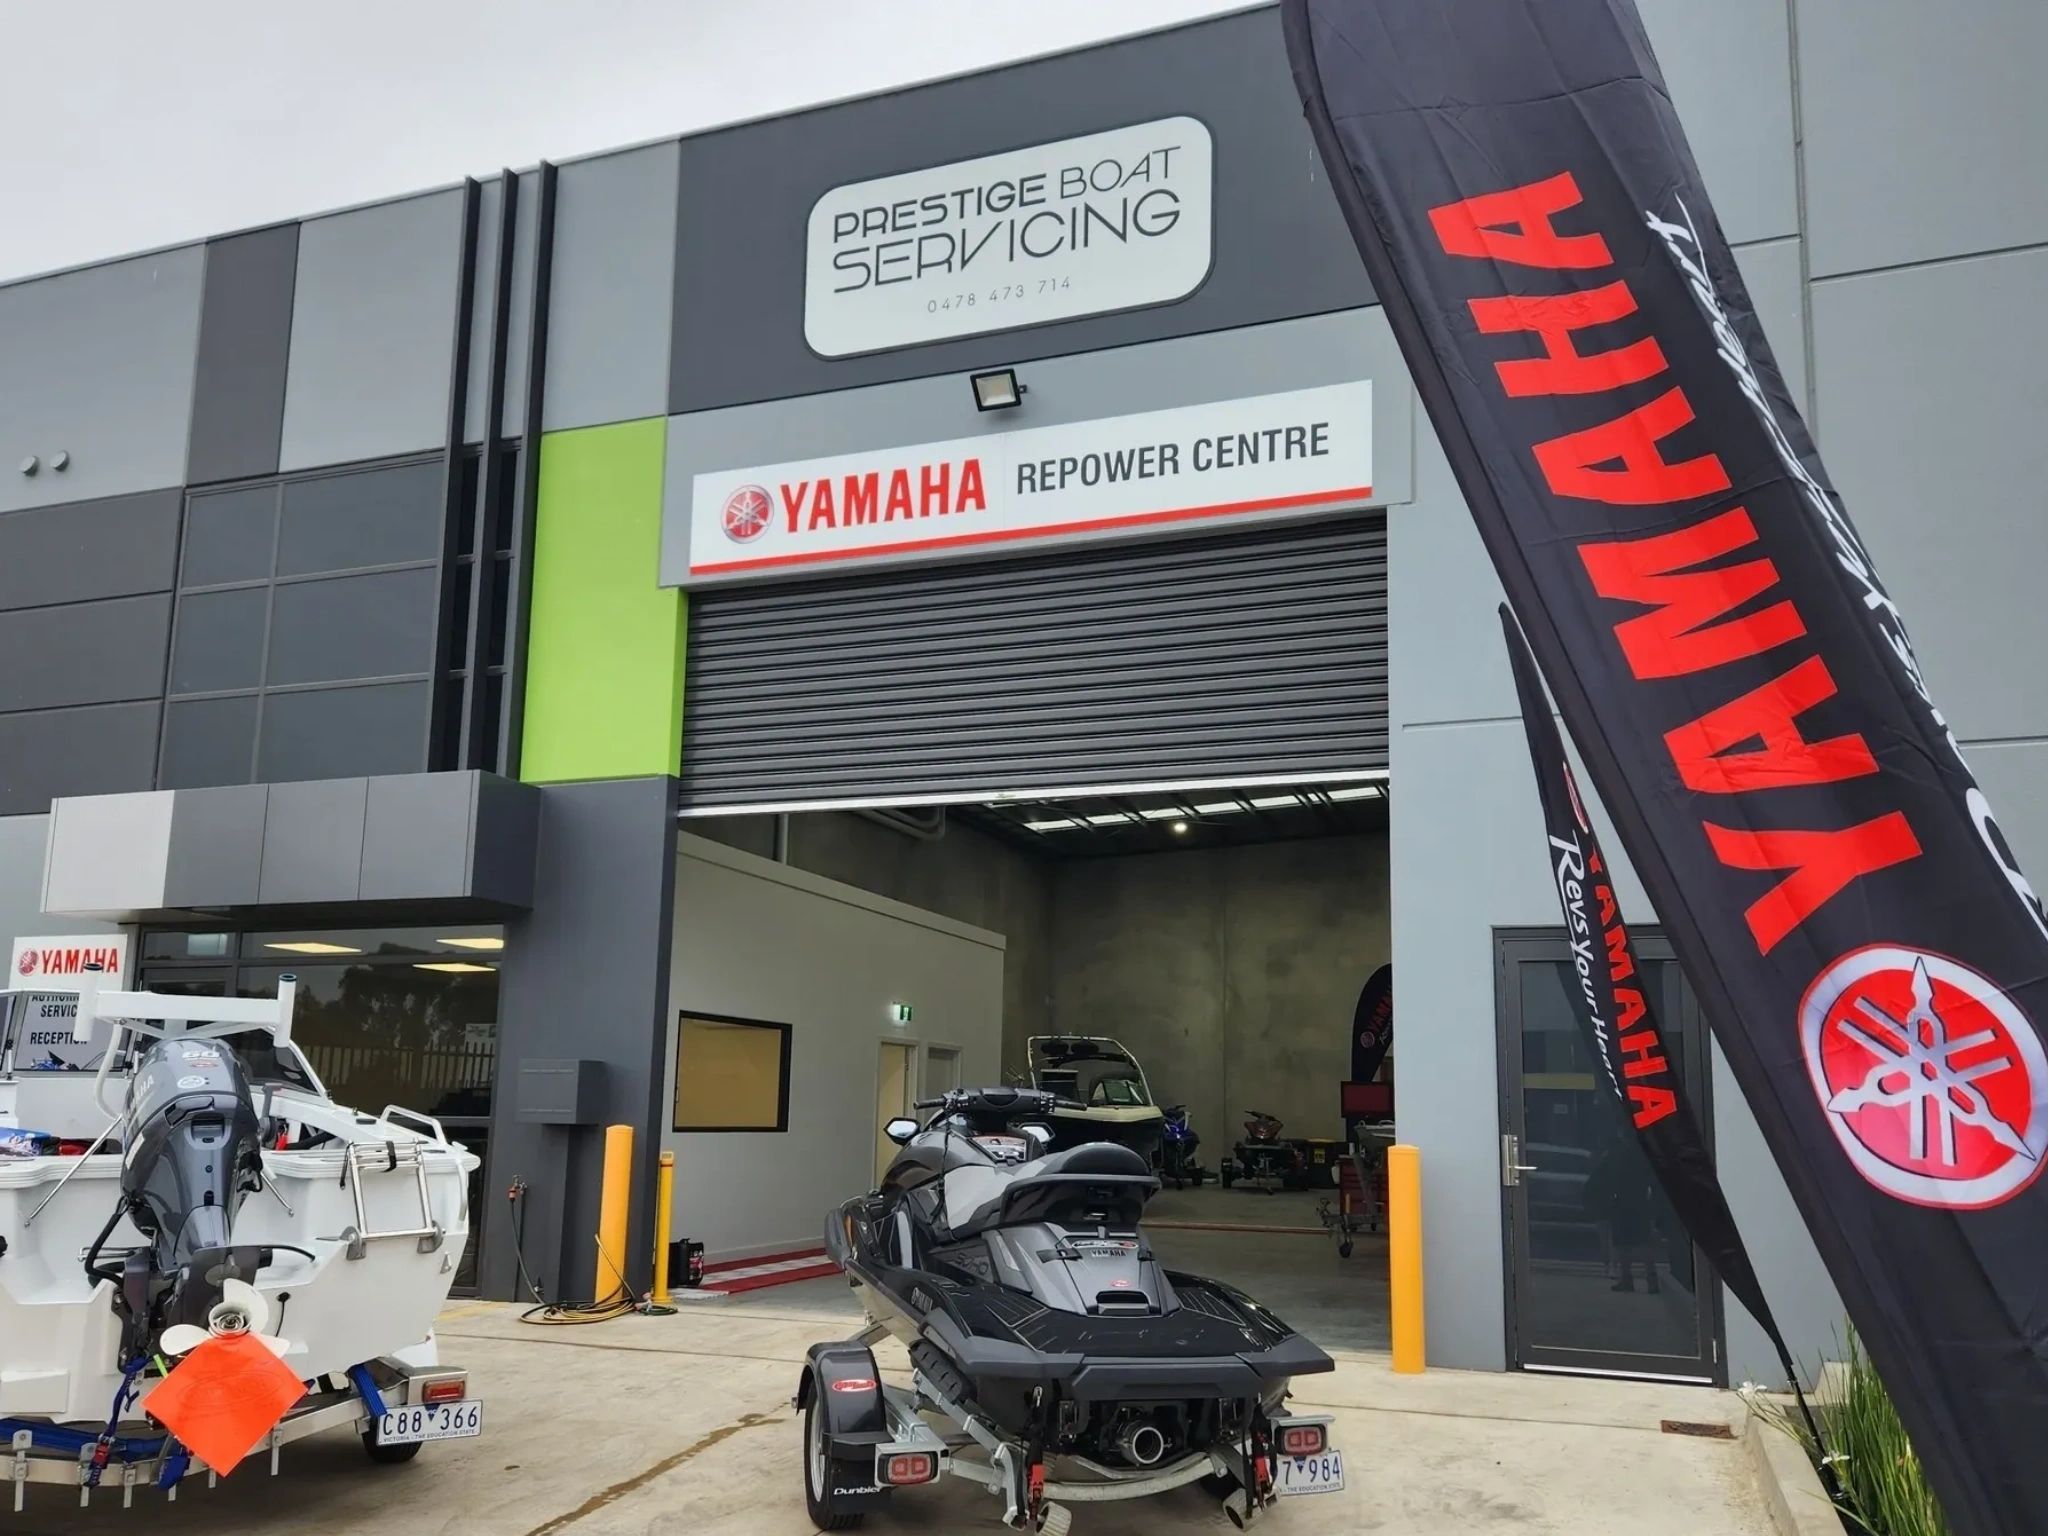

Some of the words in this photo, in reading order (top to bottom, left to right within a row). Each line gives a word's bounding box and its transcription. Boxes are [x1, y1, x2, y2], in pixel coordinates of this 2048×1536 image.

[833, 172, 1047, 244] PRESTIGE
[1060, 145, 1182, 200] BOAT
[832, 188, 1182, 294] SERVICING
[926, 292, 977, 313] 0478
[989, 284, 1026, 303] 473
[1038, 276, 1072, 294] 714
[780, 458, 987, 533] YAMAHA
[1016, 443, 1180, 495] REPOWER
[1192, 422, 1330, 472] CENTRE
[1427, 171, 1923, 957] YAMAHA
[41, 947, 119, 974] YAMAHA
[40, 1004, 79, 1018] SERVIC
[30, 1031, 88, 1045] RECEPTI
[383, 1411, 422, 1436] C88
[440, 1405, 478, 1431] 366
[1309, 1456, 1340, 1482] 984
